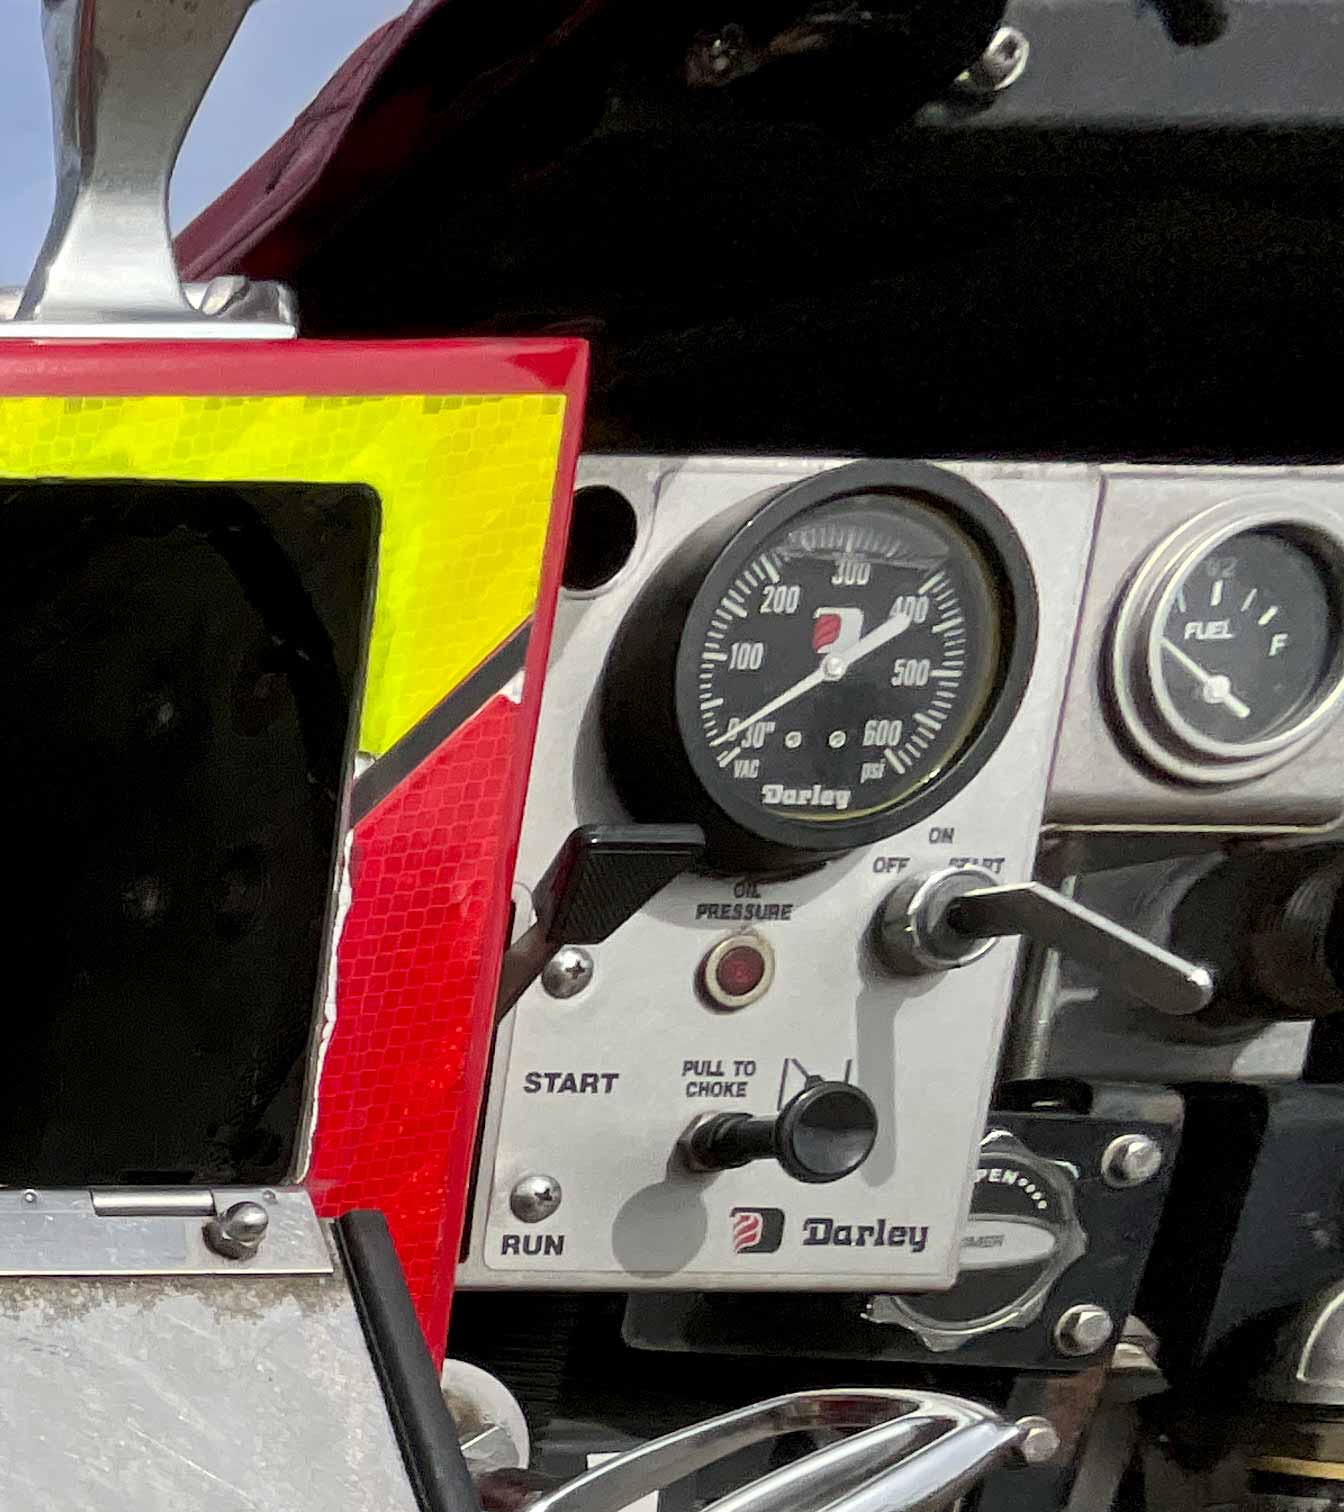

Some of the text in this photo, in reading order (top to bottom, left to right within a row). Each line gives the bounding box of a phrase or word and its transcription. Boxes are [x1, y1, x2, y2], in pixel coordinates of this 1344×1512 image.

[831, 557, 872, 585] 300
[759, 584, 801, 614] 200
[1184, 618, 1234, 640] FUEL
[729, 642, 764, 671] 100
[1268, 633, 1289, 657] F
[891, 658, 931, 686] 500
[863, 719, 903, 747] 600
[733, 759, 760, 779] VAC
[861, 758, 885, 783] psi
[762, 783, 851, 810] Darley
[928, 827, 955, 844] ON
[872, 856, 911, 873] OFF
[733, 881, 761, 898] OIL
[695, 903, 793, 920] PRESSURE
[681, 1059, 757, 1077] PULL TO
[523, 1071, 620, 1094] START
[685, 1080, 748, 1098] CHOKE
[976, 1168, 1020, 1185] PEN
[500, 1233, 565, 1256] RUN
[802, 1217, 929, 1253] Darley
